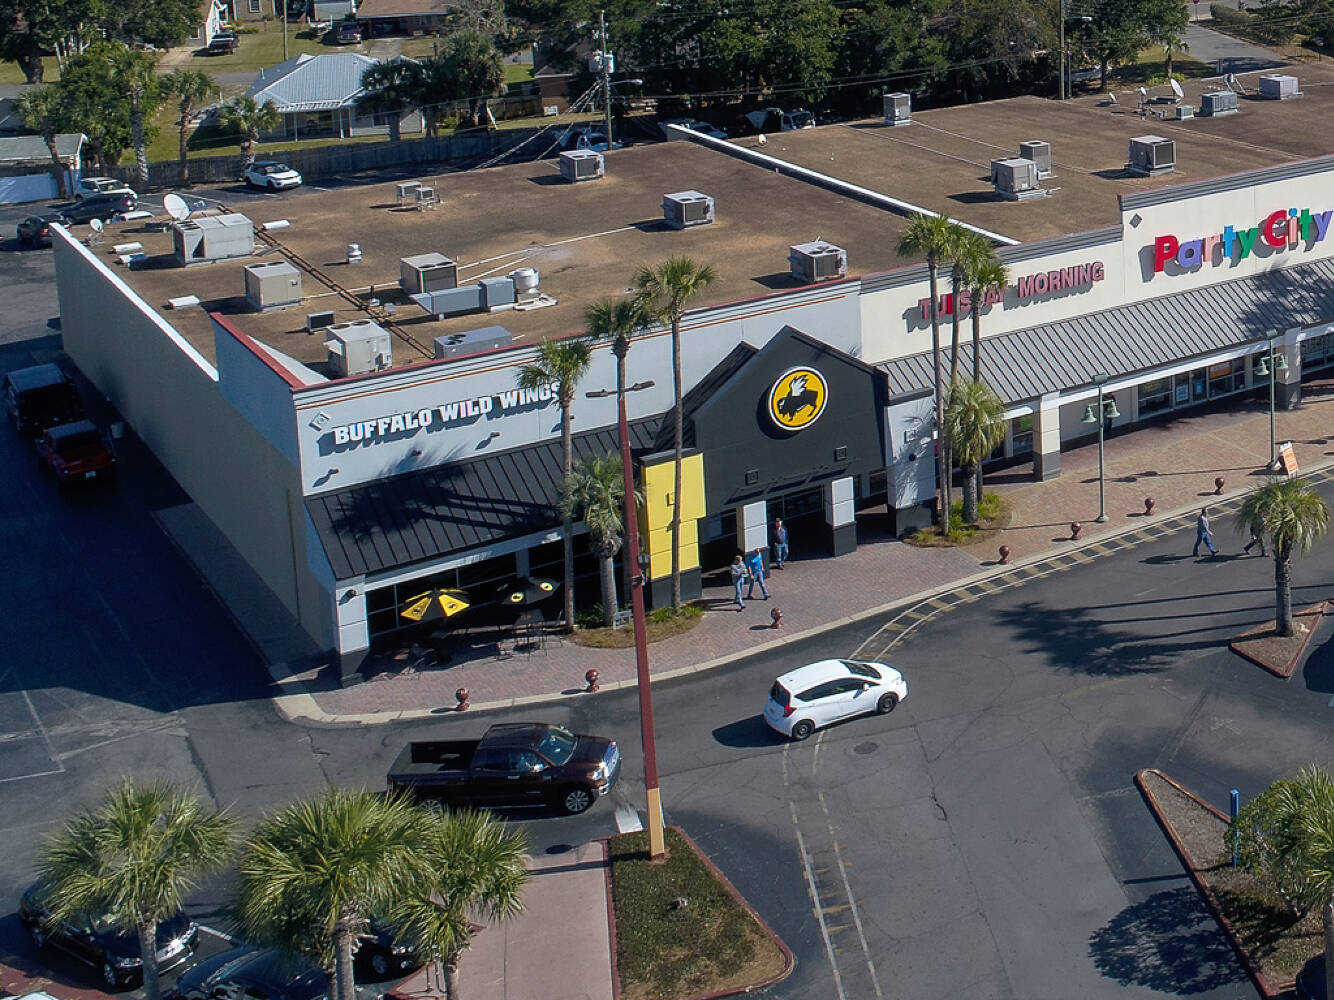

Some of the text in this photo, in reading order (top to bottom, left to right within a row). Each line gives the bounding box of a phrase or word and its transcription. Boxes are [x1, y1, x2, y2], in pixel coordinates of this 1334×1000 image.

[1154, 206, 1334, 273] Party City
[1017, 261, 1104, 299] MORNING
[334, 381, 561, 445] BUFFALO WILD WINGS
